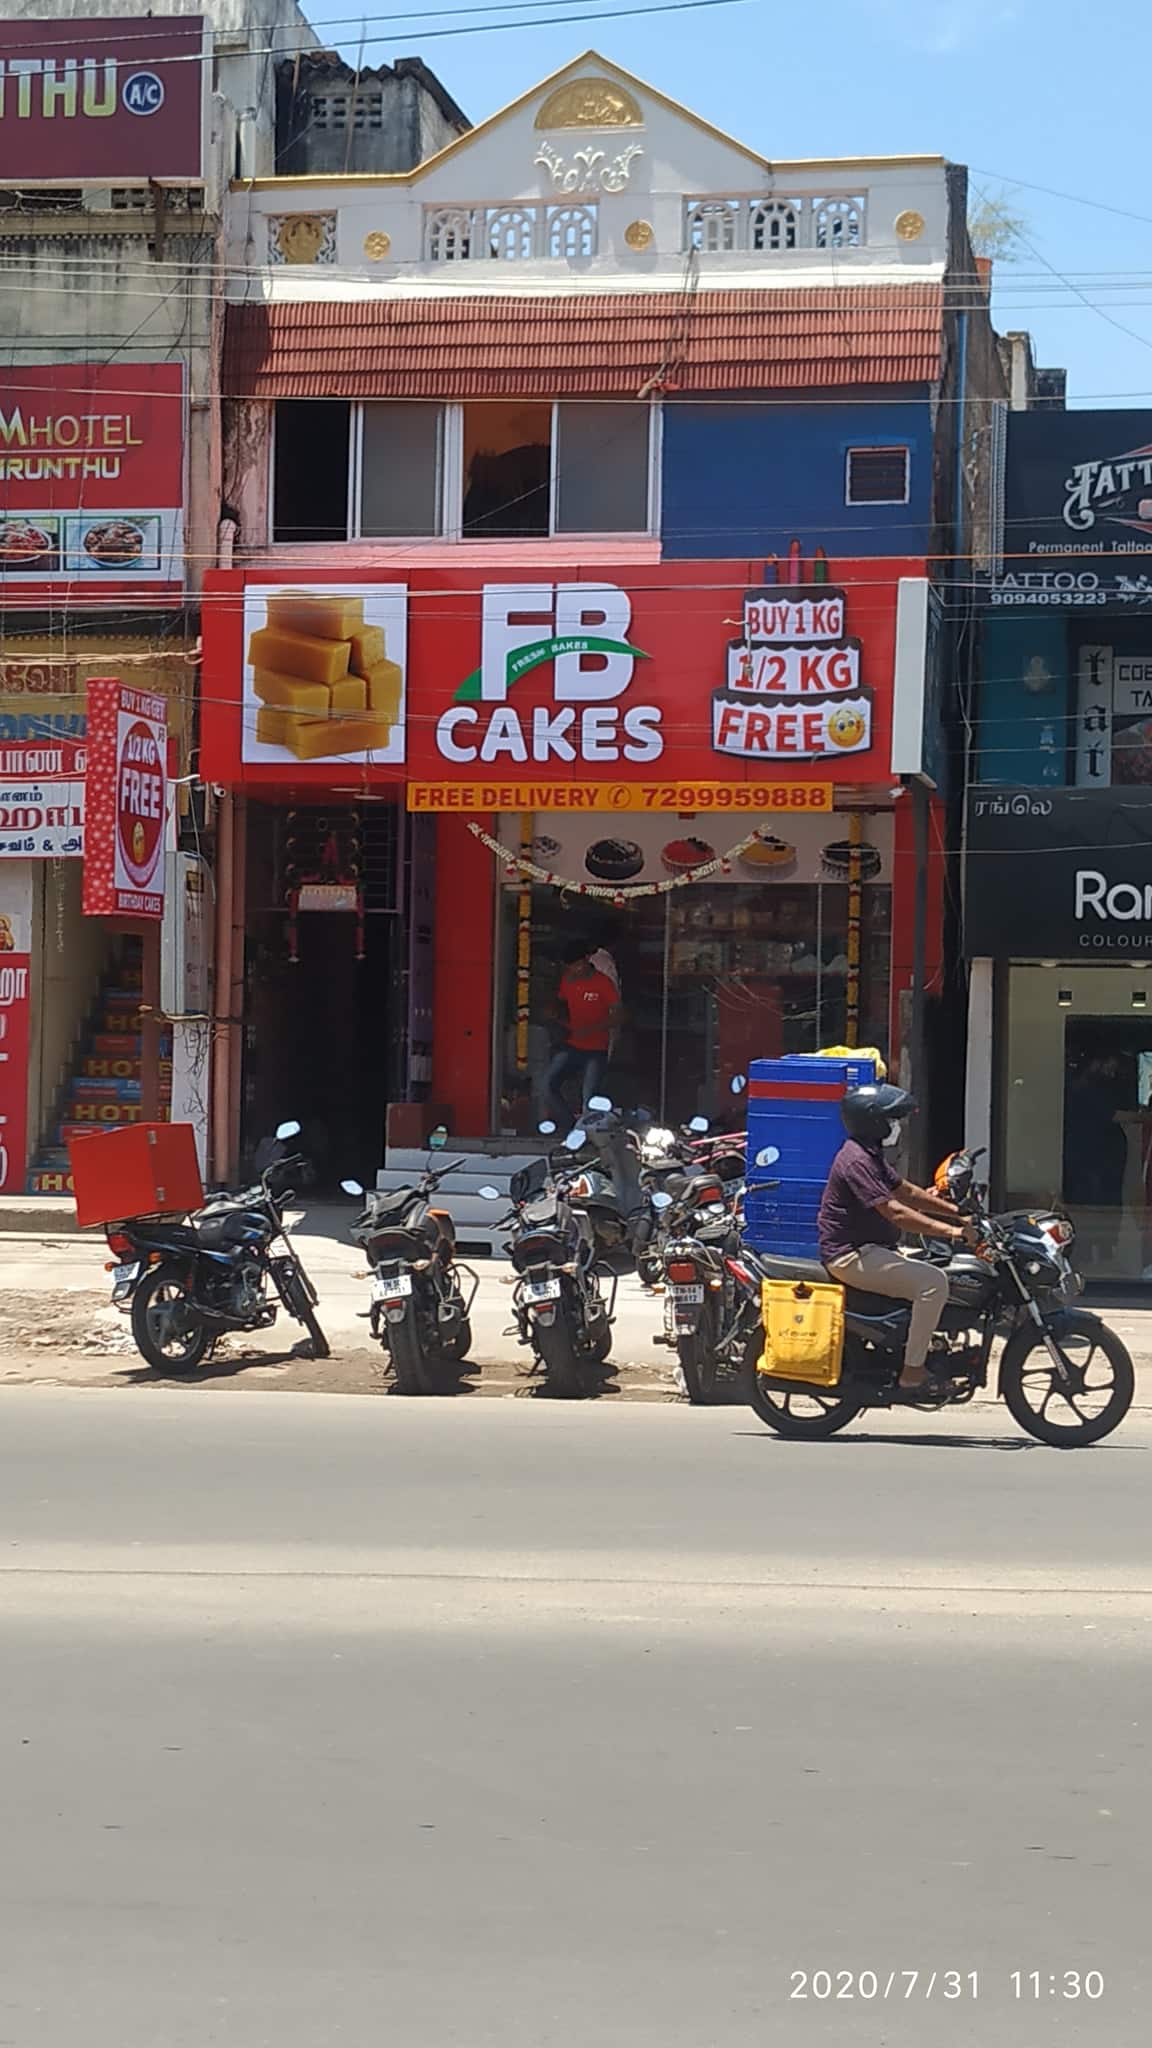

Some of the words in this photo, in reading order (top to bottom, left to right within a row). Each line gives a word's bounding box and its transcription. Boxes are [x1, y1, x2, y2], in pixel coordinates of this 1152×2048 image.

[0, 59, 117, 118] THU
[129, 83, 160, 105] A/C
[1028, 541, 1104, 553] Permanent
[991, 592, 1106, 605] 9094053223
[748, 606, 790, 636] BUY
[795, 605, 806, 634] 1
[812, 605, 840, 634] KG
[481, 583, 634, 701] FB
[551, 641, 588, 653] BAKES
[734, 652, 787, 690] 1/2
[800, 652, 852, 691] KG
[436, 706, 663, 762] CAKES
[717, 707, 826, 752] FREE
[142, 738, 155, 766] KG
[121, 767, 161, 819] FREE
[414, 788, 475, 807] FREE
[482, 787, 599, 807] DELIVERY
[642, 787, 826, 807] 7299959888
